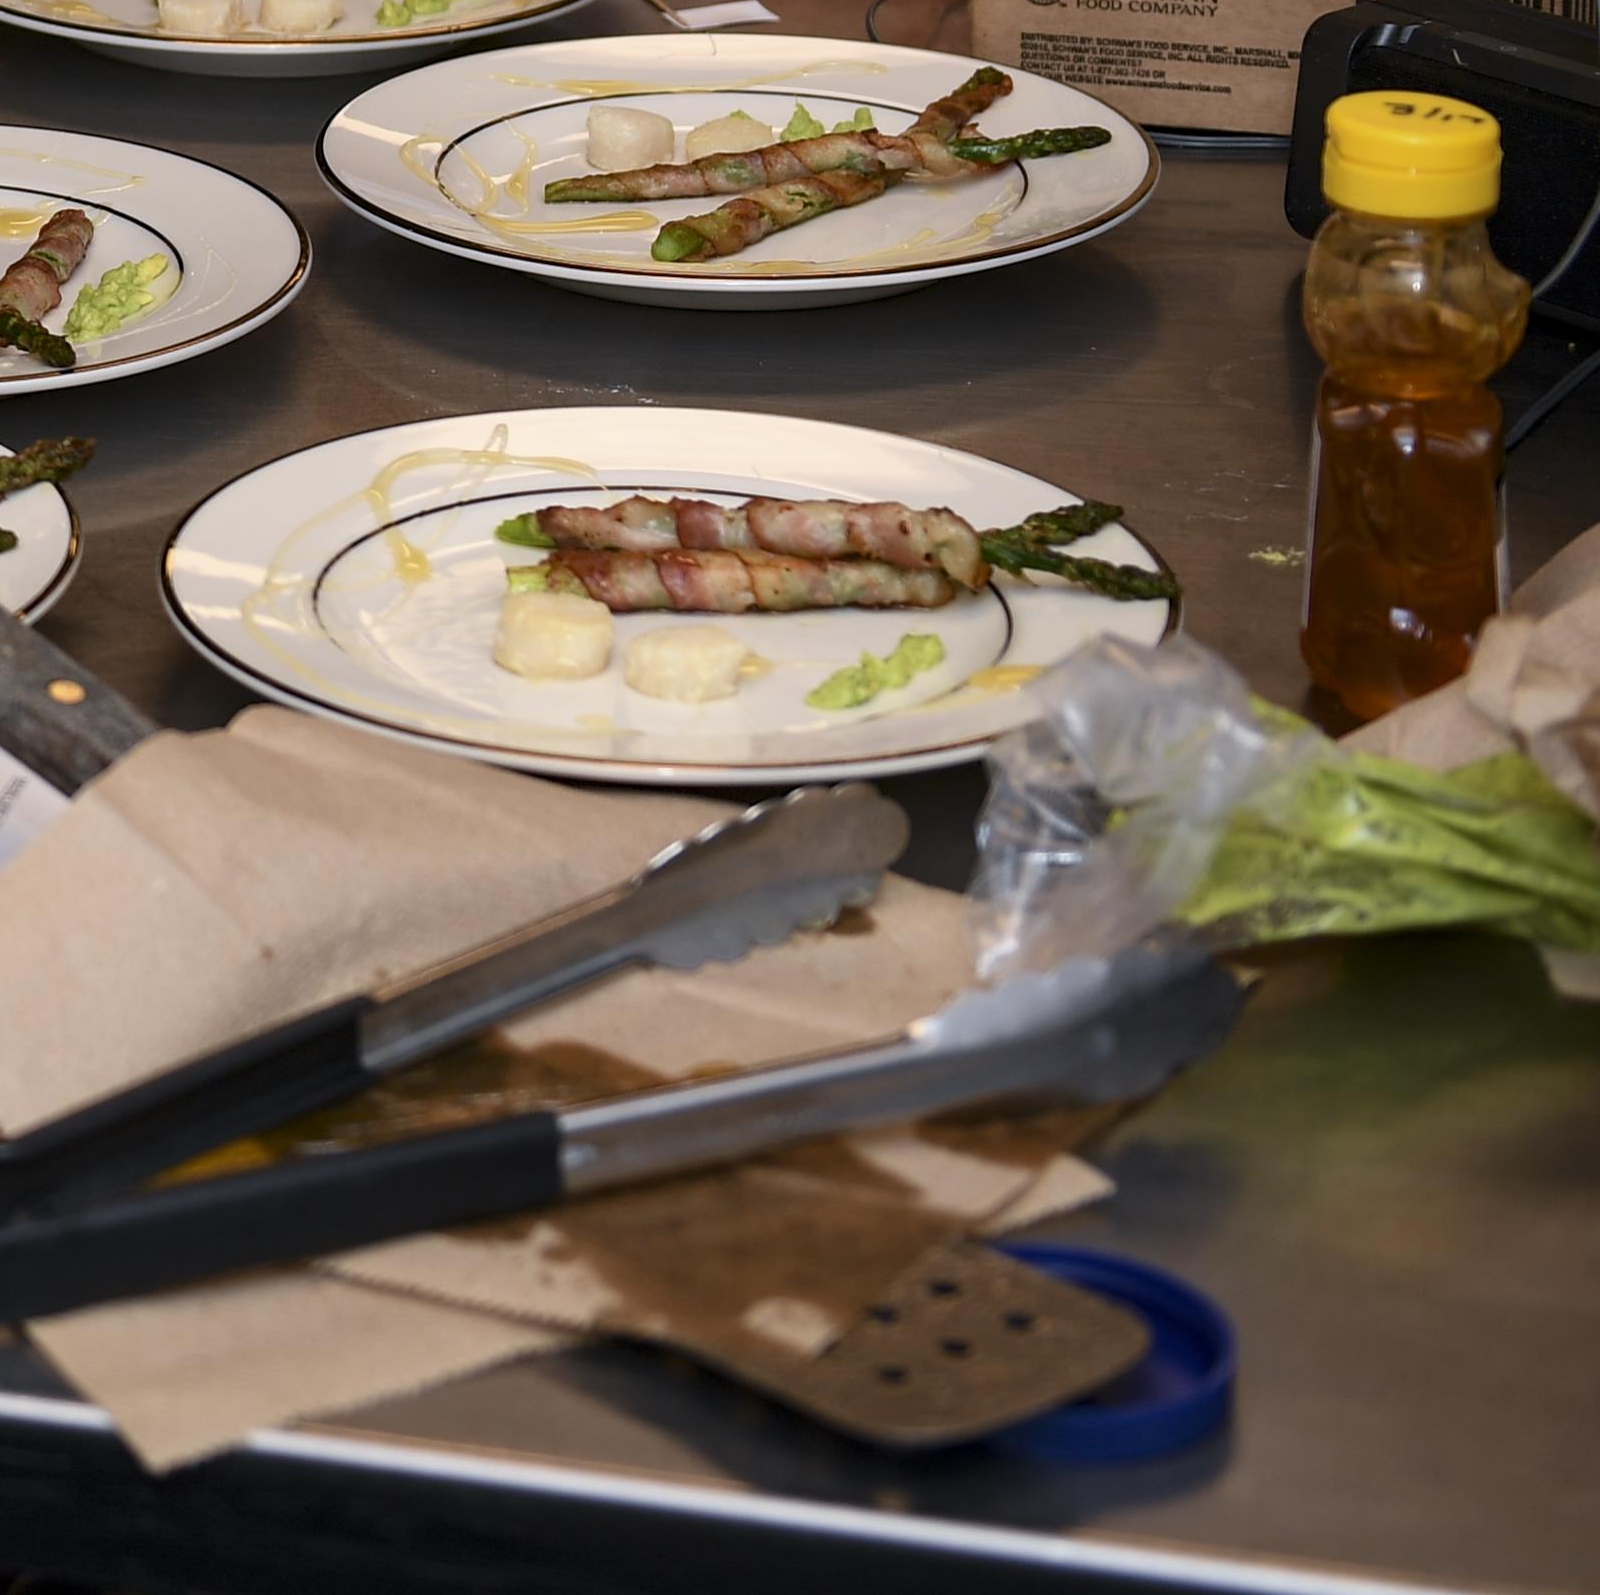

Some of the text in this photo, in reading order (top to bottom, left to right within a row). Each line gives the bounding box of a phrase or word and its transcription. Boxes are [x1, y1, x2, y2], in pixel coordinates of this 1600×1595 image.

[1128, 0, 1218, 17] COMPANY
[1021, 32, 1078, 44] DISTRIBUTED
[1144, 40, 1169, 50] FOOD
[1021, 51, 1070, 62] QUESTIONS
[1072, 54, 1085, 63] OR
[1099, 47, 1124, 56] FOOD
[1186, 54, 1203, 63] ALL
[1205, 55, 1239, 66] RIGHTS
[1021, 61, 1062, 72] CONTACT
[1064, 63, 1075, 72] US
[1076, 65, 1087, 73] AT
